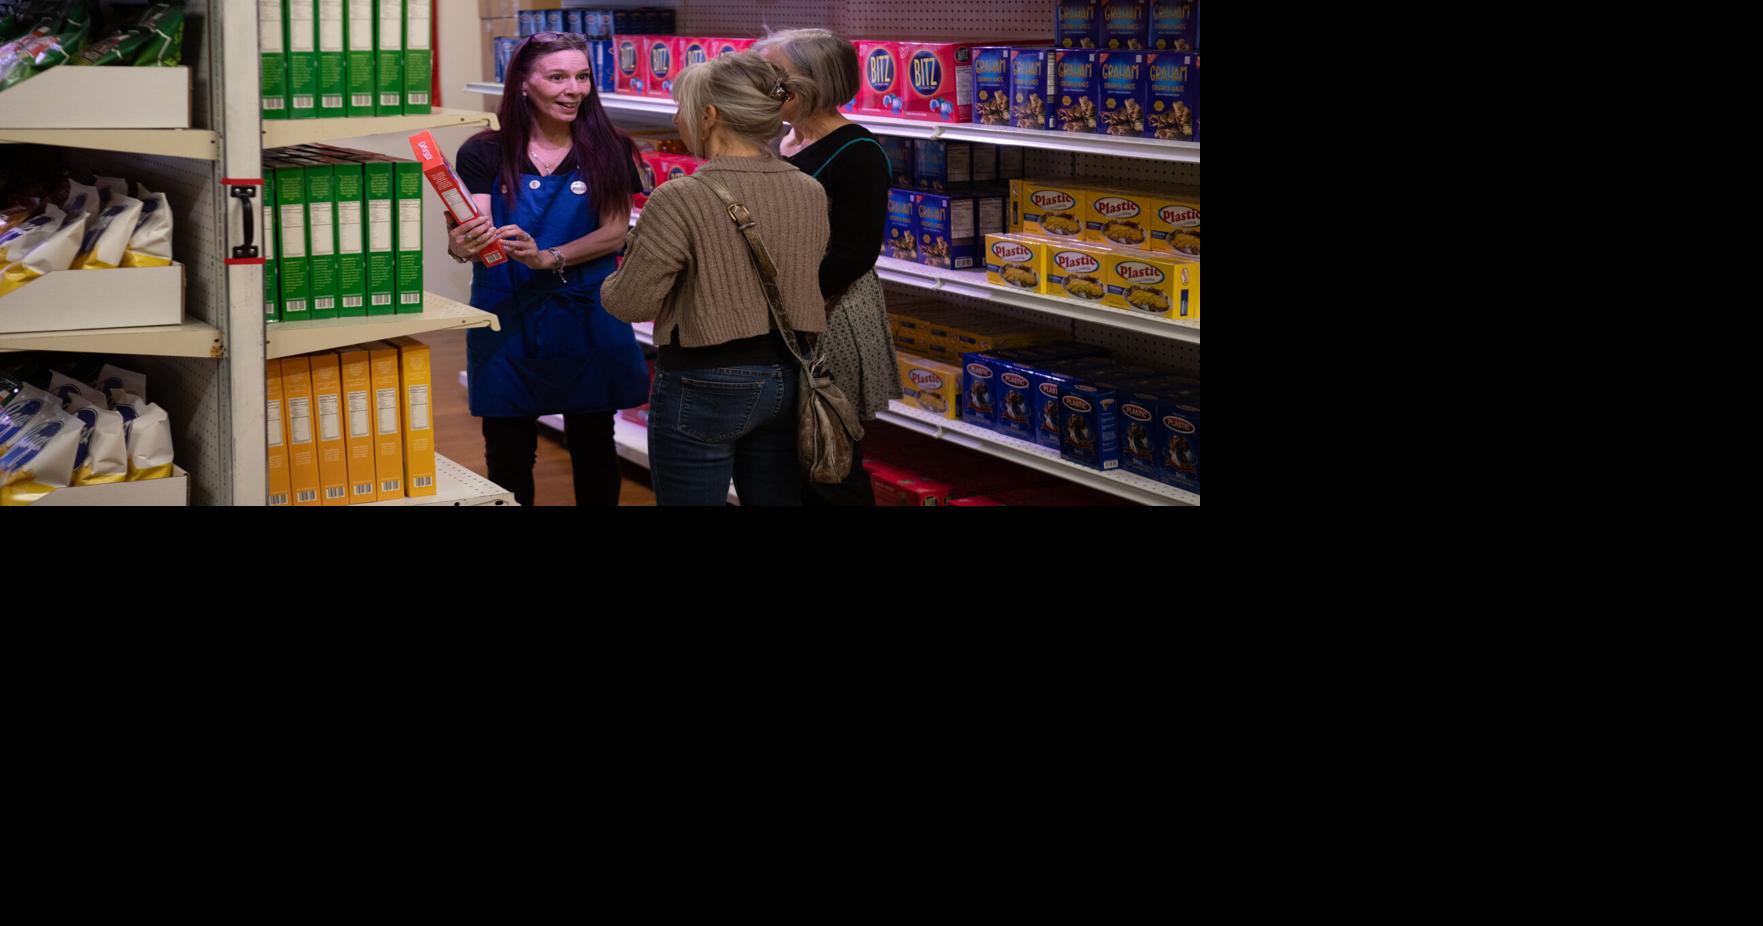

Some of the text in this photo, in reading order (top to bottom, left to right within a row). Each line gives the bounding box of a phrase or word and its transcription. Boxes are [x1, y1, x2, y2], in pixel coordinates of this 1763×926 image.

[870, 55, 891, 83] BITZ
[914, 57, 937, 87] BITZ
[1102, 63, 1139, 80] GRAHAM
[1149, 65, 1188, 82] GRAHAM
[1034, 193, 1072, 207] Plastic
[1098, 201, 1137, 215] Plastic
[1162, 209, 1200, 224] Plastic
[995, 245, 1029, 258] Plastic
[1058, 255, 1096, 269] Plastic
[1120, 266, 1160, 279] Plastic
[911, 372, 940, 384] Plastic
[1004, 375, 1025, 386] PLASTIC
[1066, 399, 1087, 410] PLASTIC
[1167, 418, 1191, 431] PLASTIC
